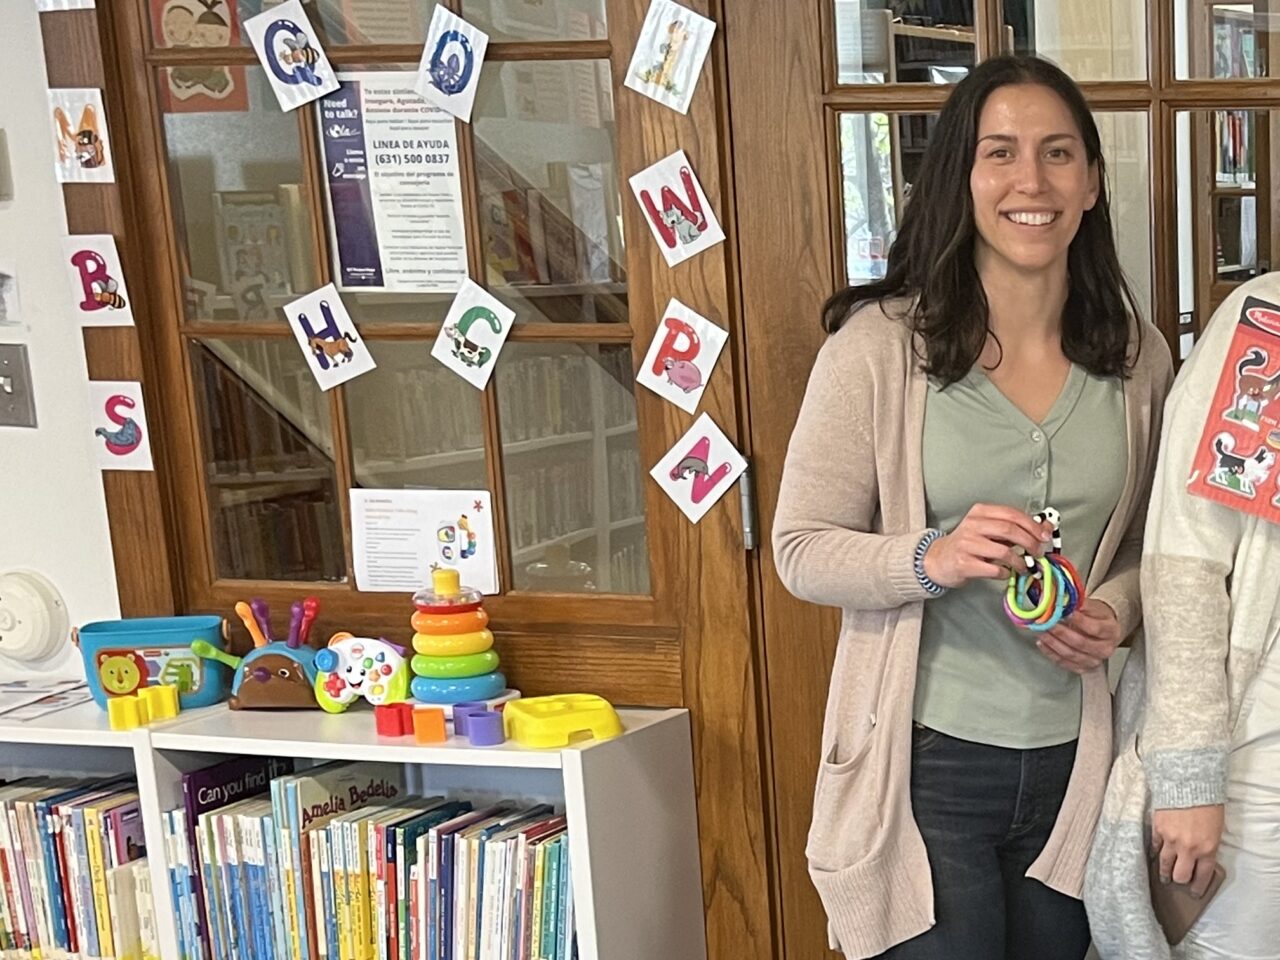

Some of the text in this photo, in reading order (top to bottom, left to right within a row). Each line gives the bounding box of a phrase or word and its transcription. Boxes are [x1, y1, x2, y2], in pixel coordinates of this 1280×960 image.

[264, 19, 322, 87] Q
[323, 99, 348, 109] Need
[324, 108, 358, 119] to talk?
[373, 139, 450, 150] LINEA DE AYUDA
[375, 153, 451, 165] (631) 500 0837
[639, 165, 709, 249] W
[70, 249, 114, 313] B
[297, 299, 354, 371] H
[455, 305, 503, 368] C
[651, 316, 702, 377] P
[104, 394, 143, 456] S
[198, 784, 221, 805] Can
[222, 779, 244, 802] you
[244, 765, 266, 790] find
[301, 777, 399, 830] Amelia Bedelia
